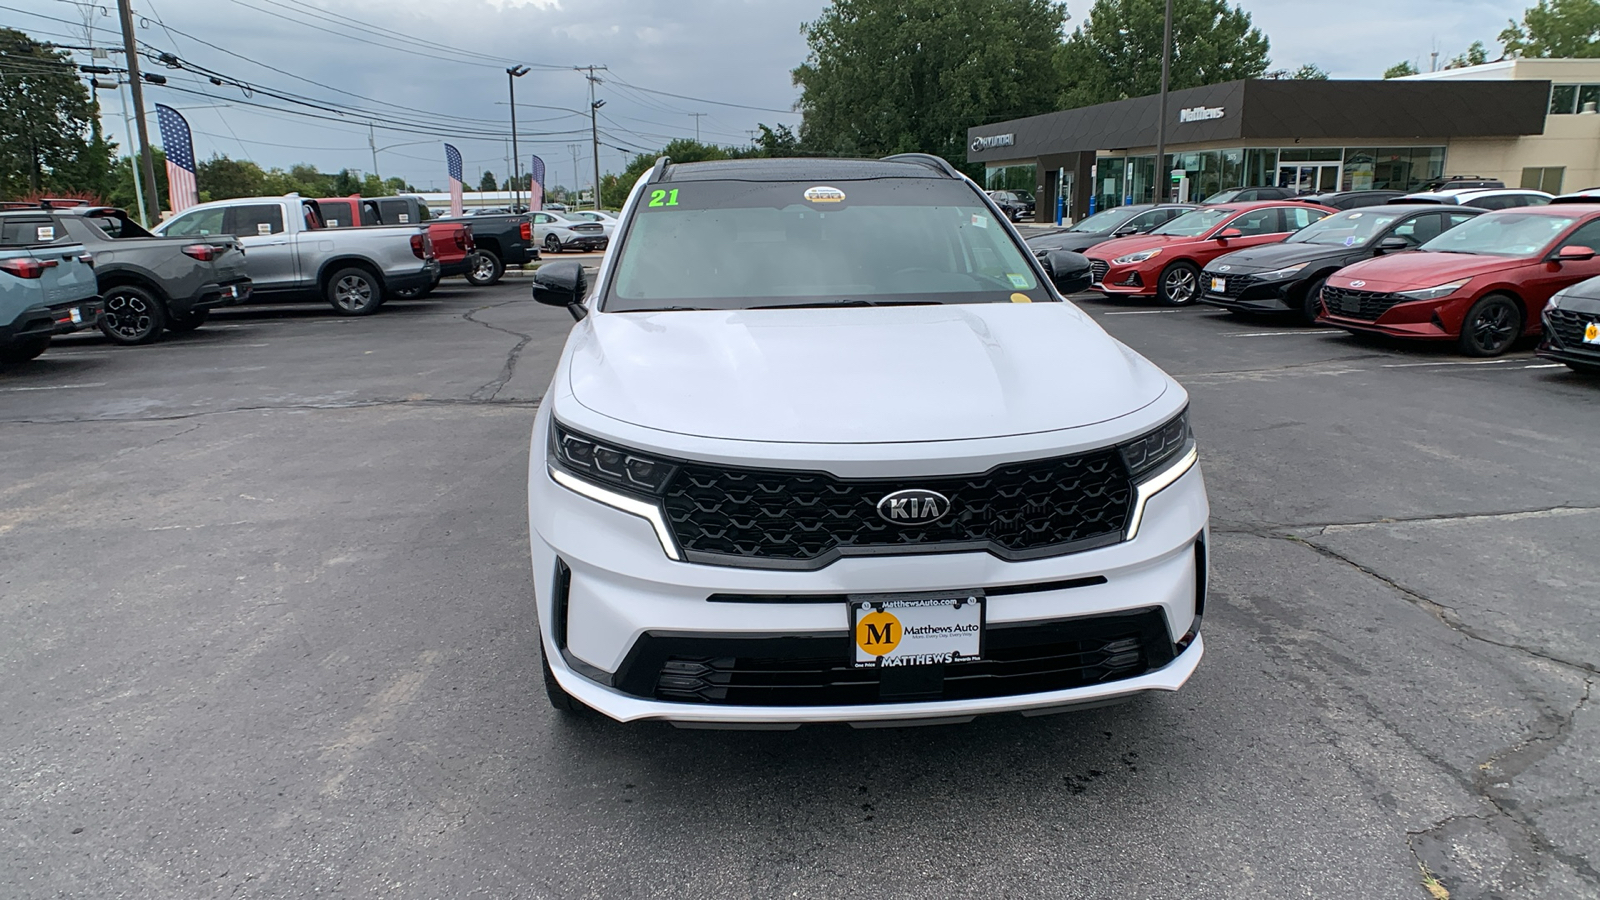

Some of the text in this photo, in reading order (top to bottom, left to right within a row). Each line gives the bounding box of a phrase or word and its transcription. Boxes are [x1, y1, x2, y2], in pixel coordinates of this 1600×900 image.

[983, 133, 1014, 148] HYUNDAI
[649, 188, 679, 207] 21
[889, 497, 940, 519] KIA
[882, 599, 957, 608] MatthewsAuto.com
[864, 622, 894, 645] M
[904, 623, 979, 635] Matthews Auto
[881, 653, 952, 667] MATTHEWS
